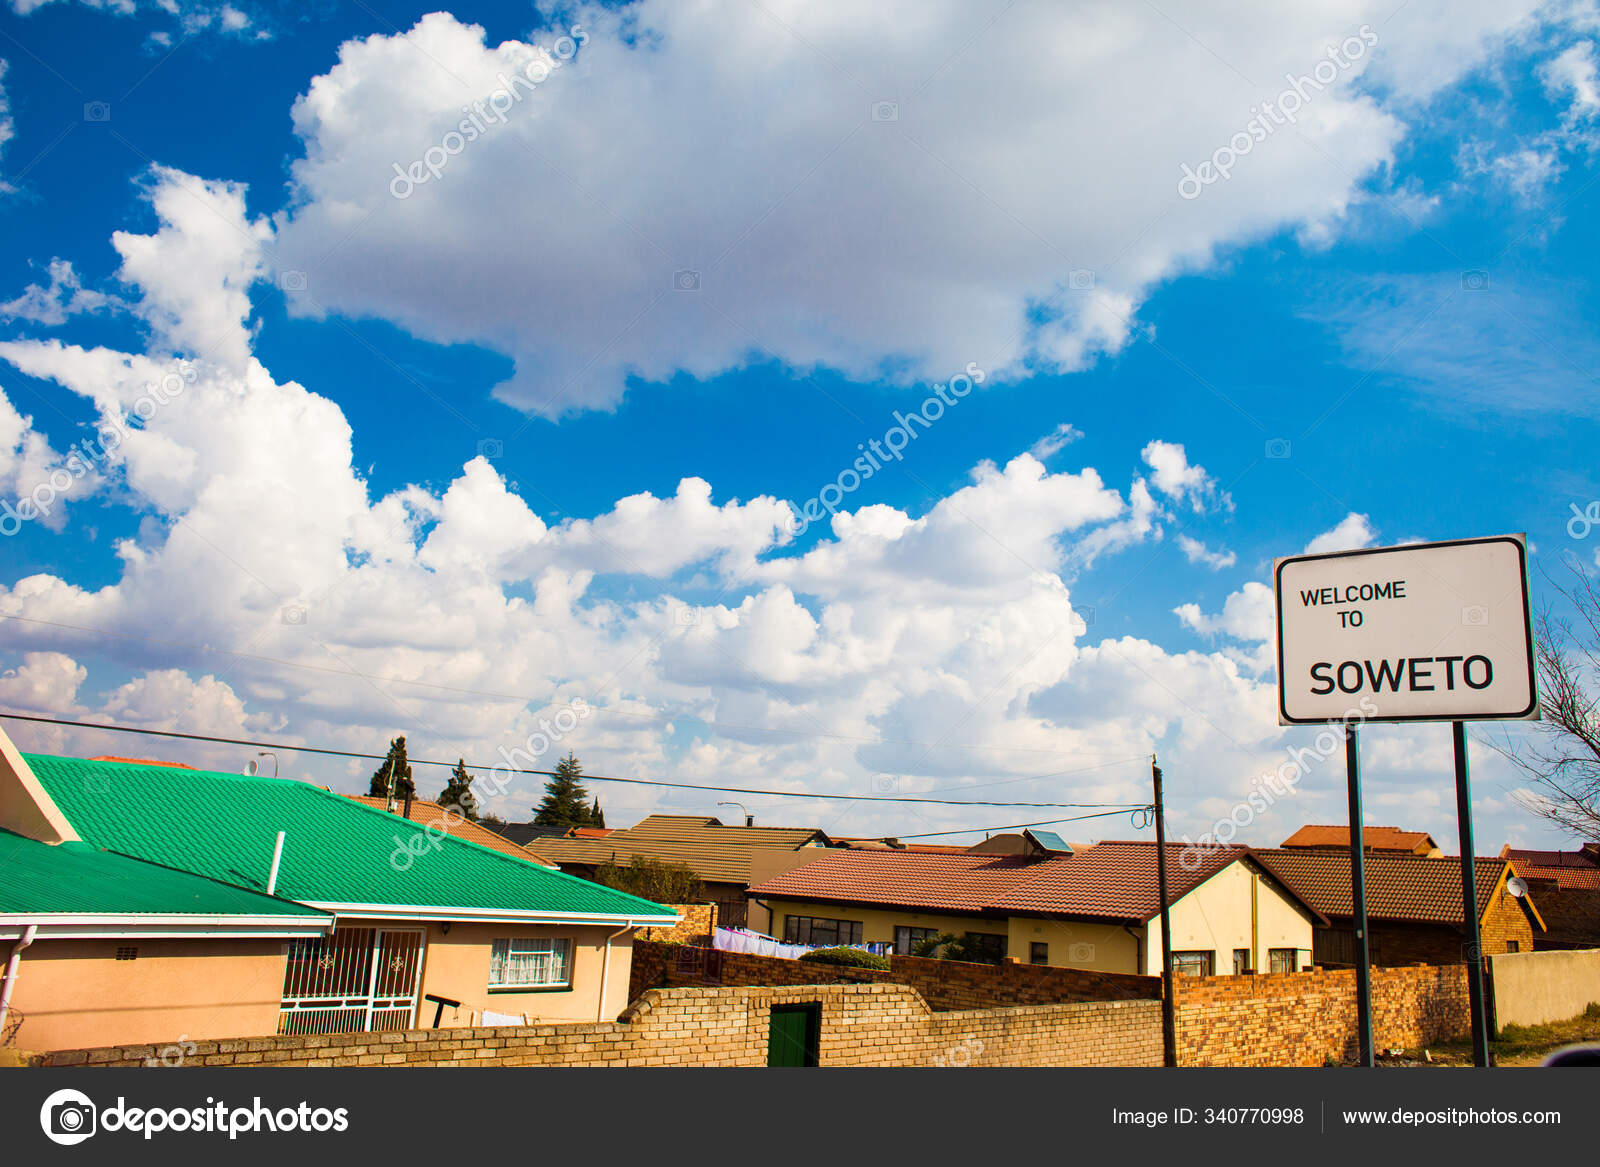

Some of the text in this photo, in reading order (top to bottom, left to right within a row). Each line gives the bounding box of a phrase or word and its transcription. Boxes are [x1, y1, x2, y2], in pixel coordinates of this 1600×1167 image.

[1300, 580, 1407, 607] WELCOME
[1337, 610, 1364, 629] TO
[1310, 654, 1494, 696] SOWETO
